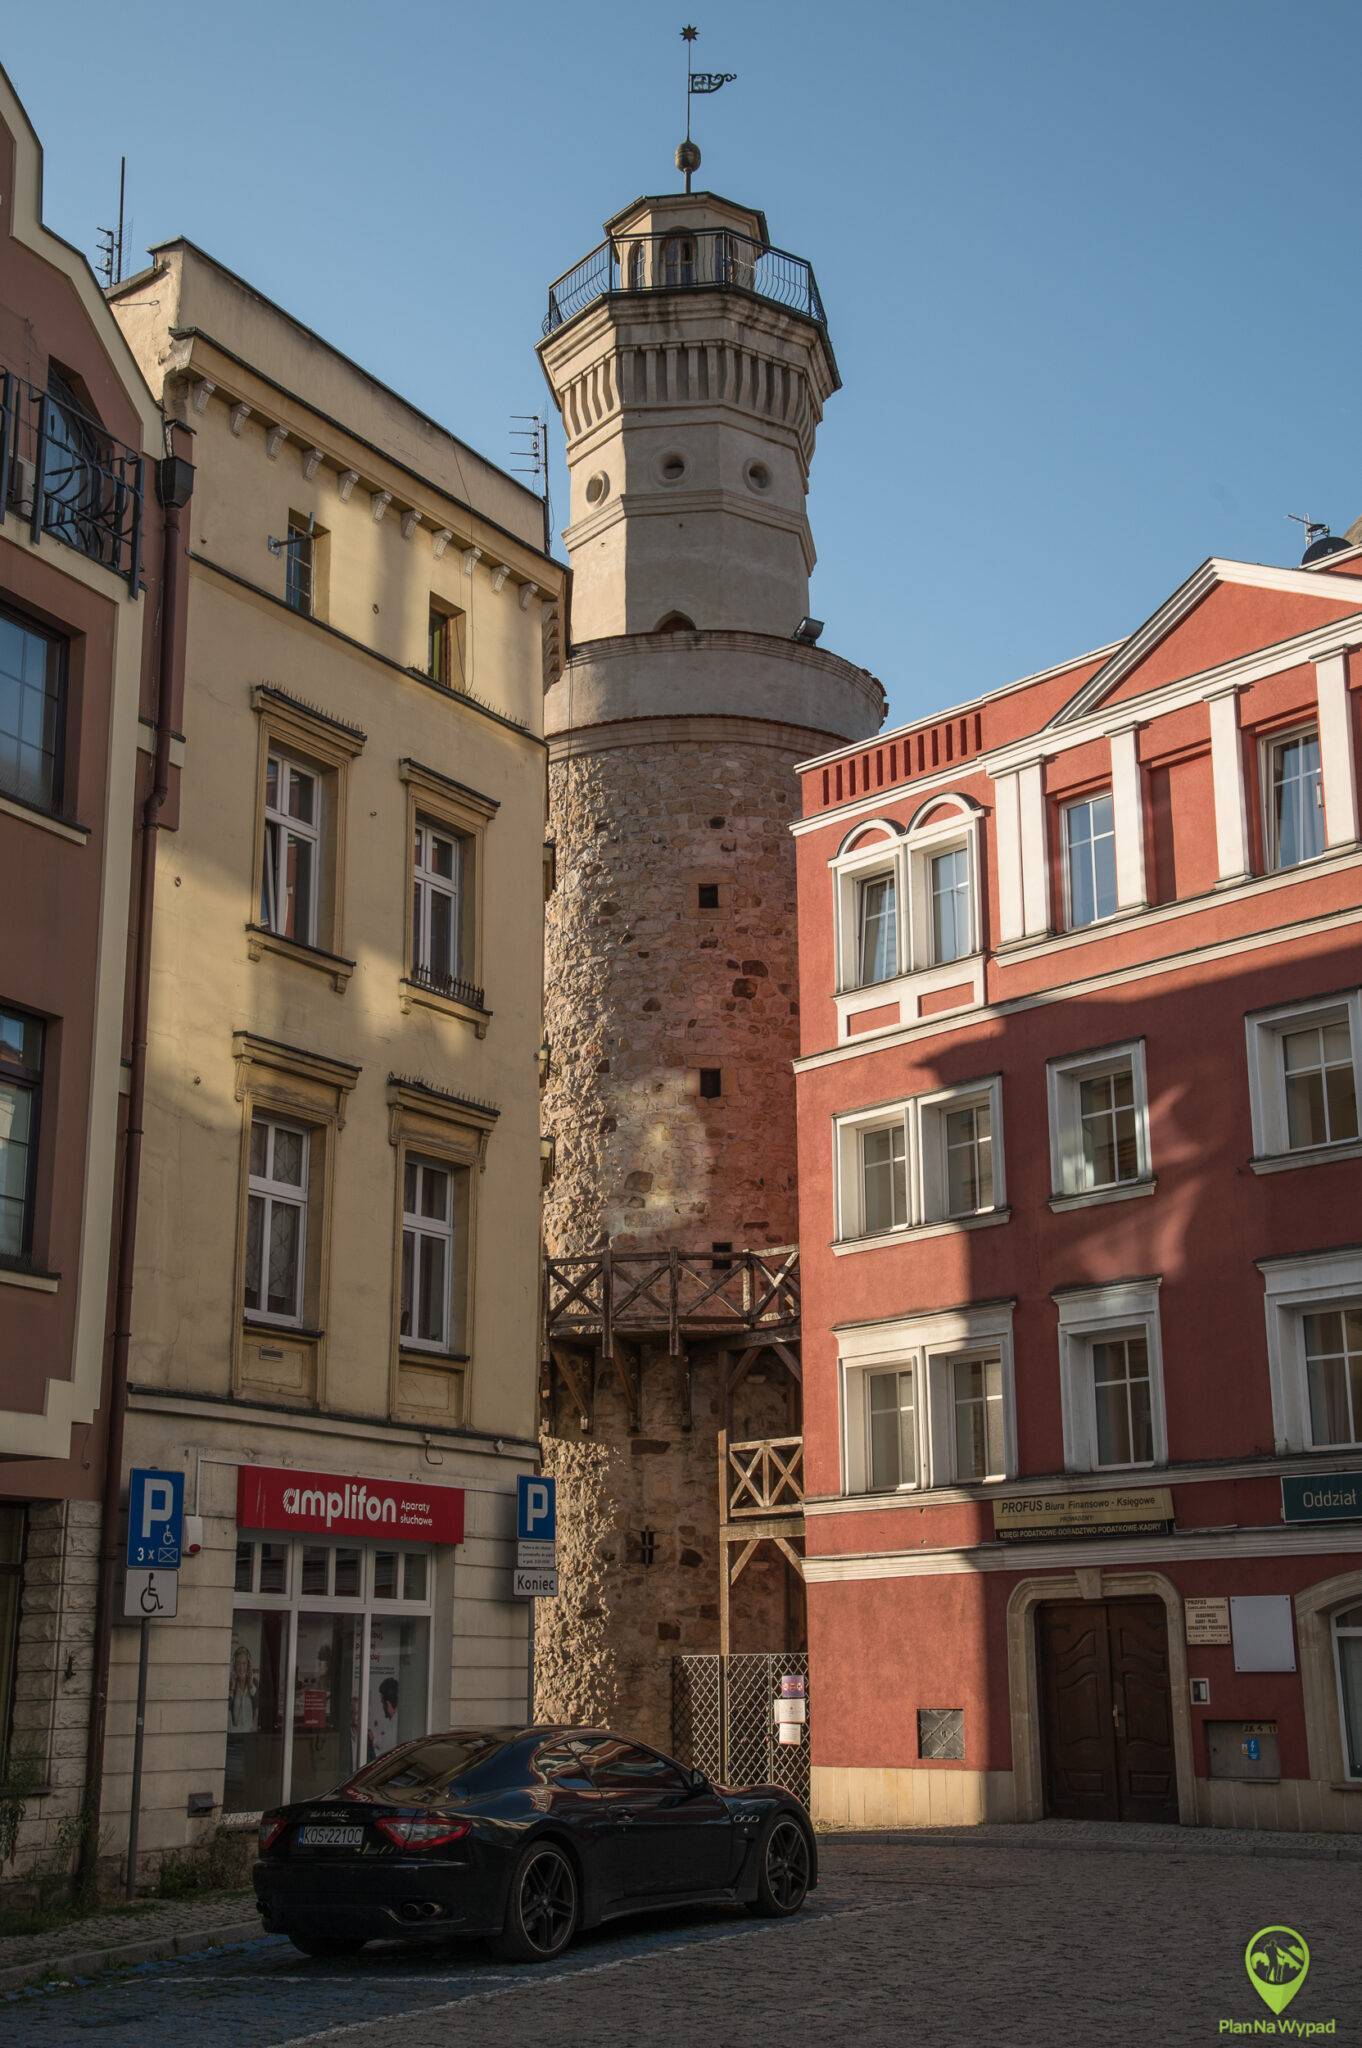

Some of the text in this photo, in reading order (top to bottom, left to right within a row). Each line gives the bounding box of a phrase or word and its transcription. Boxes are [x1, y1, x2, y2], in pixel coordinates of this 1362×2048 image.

[283, 1483, 397, 1527] amplifon
[1001, 1500, 1043, 1513] PROFUS
[1302, 1488, 1357, 1508] Oddział
[141, 1478, 174, 1537] P
[400, 1500, 430, 1514] Aparaty
[527, 1483, 549, 1532] P
[400, 1514, 433, 1526] słuchowe
[137, 1547, 144, 1562] 3
[517, 1574, 554, 1591] Koniec
